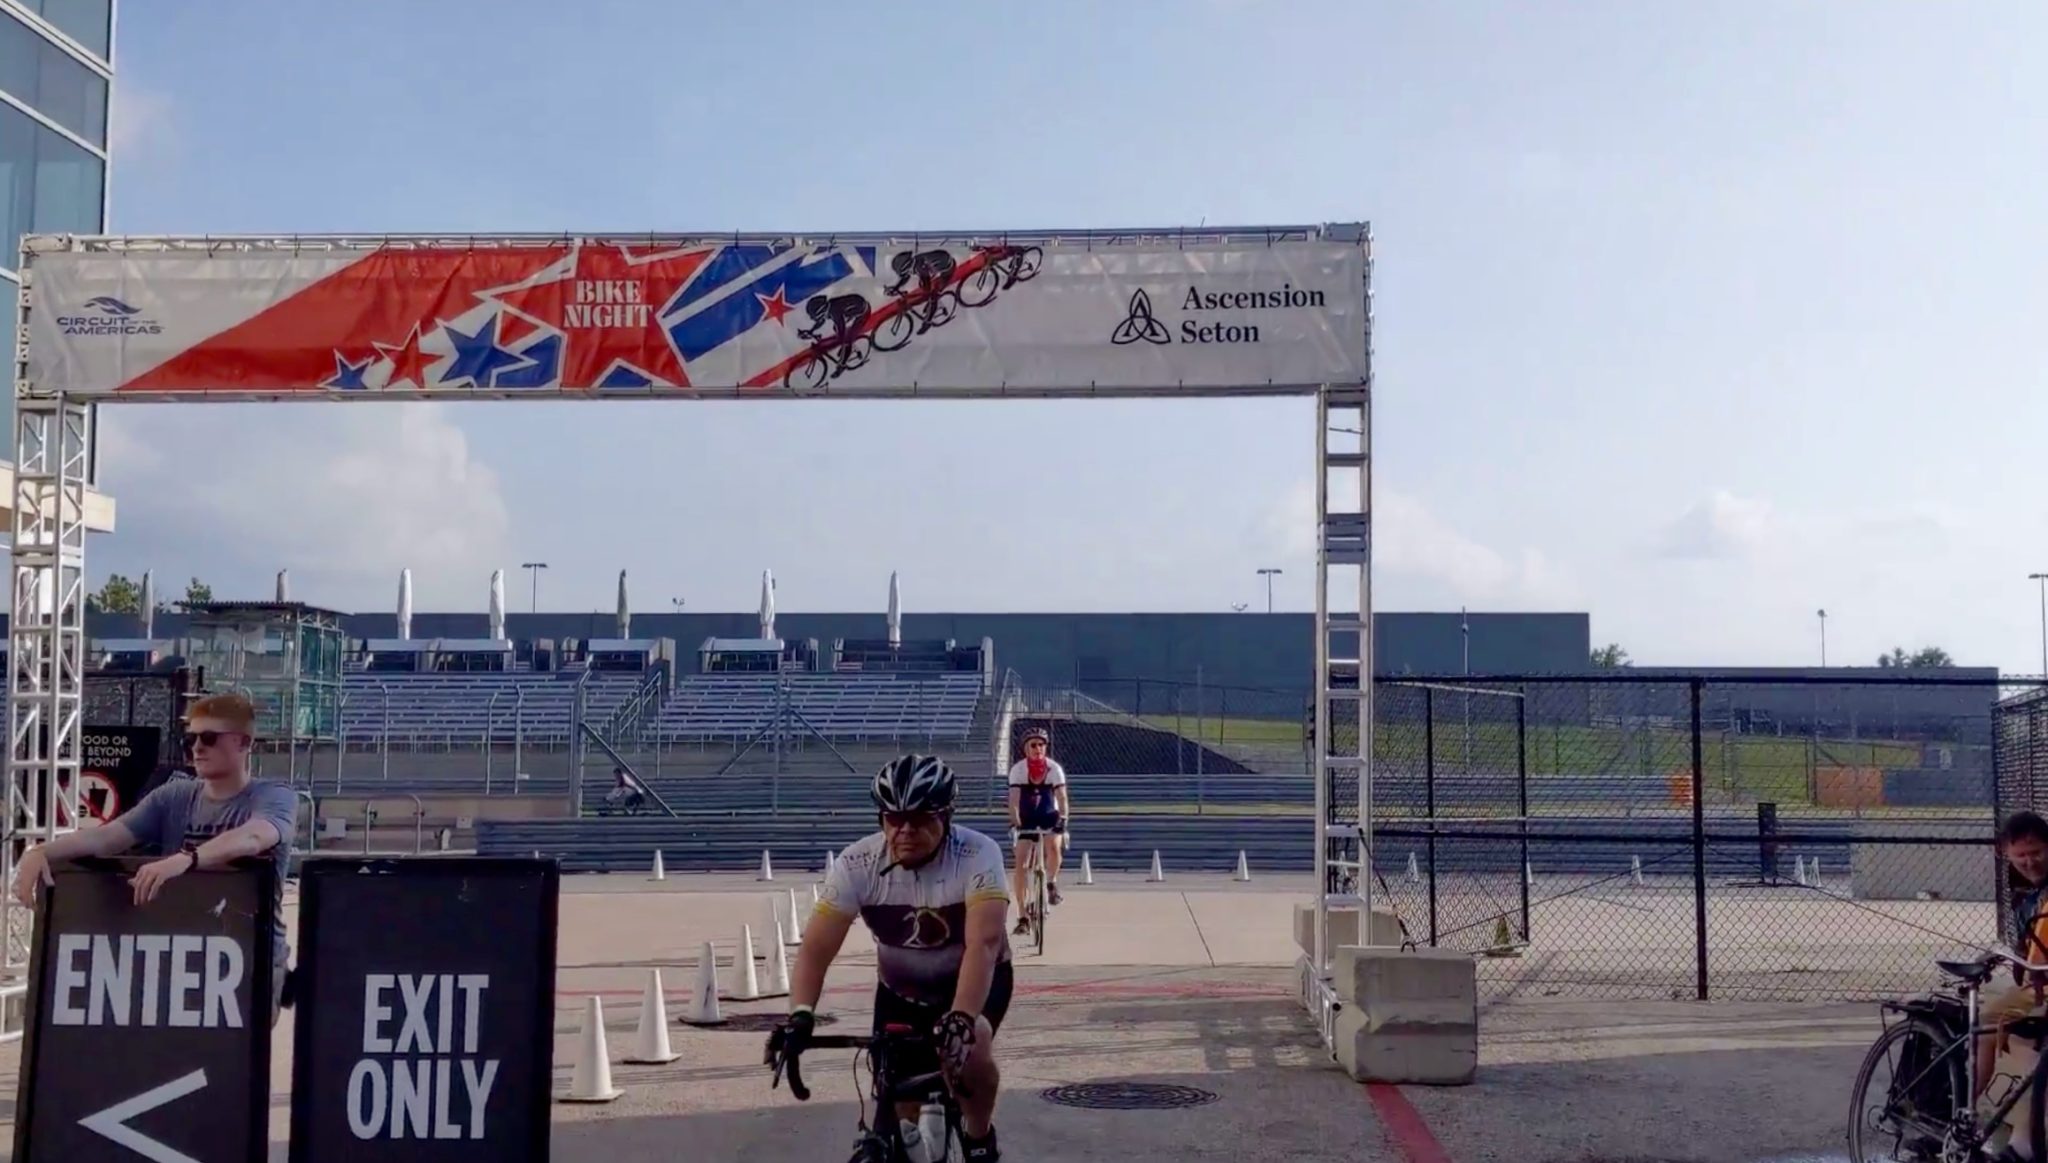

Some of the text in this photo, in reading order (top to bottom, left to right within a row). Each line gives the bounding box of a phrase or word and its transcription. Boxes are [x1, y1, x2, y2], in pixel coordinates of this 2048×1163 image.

[576, 280, 641, 304] BIKE
[1181, 283, 1326, 310] Ascension
[56, 316, 130, 326] CIRCUIT
[563, 303, 654, 328] NIGHT
[64, 325, 162, 336] AMERICAS
[1180, 319, 1260, 345] Seton
[77, 735, 109, 745] OOD
[111, 735, 128, 746] OR
[87, 746, 132, 757] BEYOND
[87, 757, 121, 768] POINT
[52, 933, 245, 1028] ENTER
[362, 973, 490, 1054] EXIT
[346, 1058, 501, 1140] ONLY
